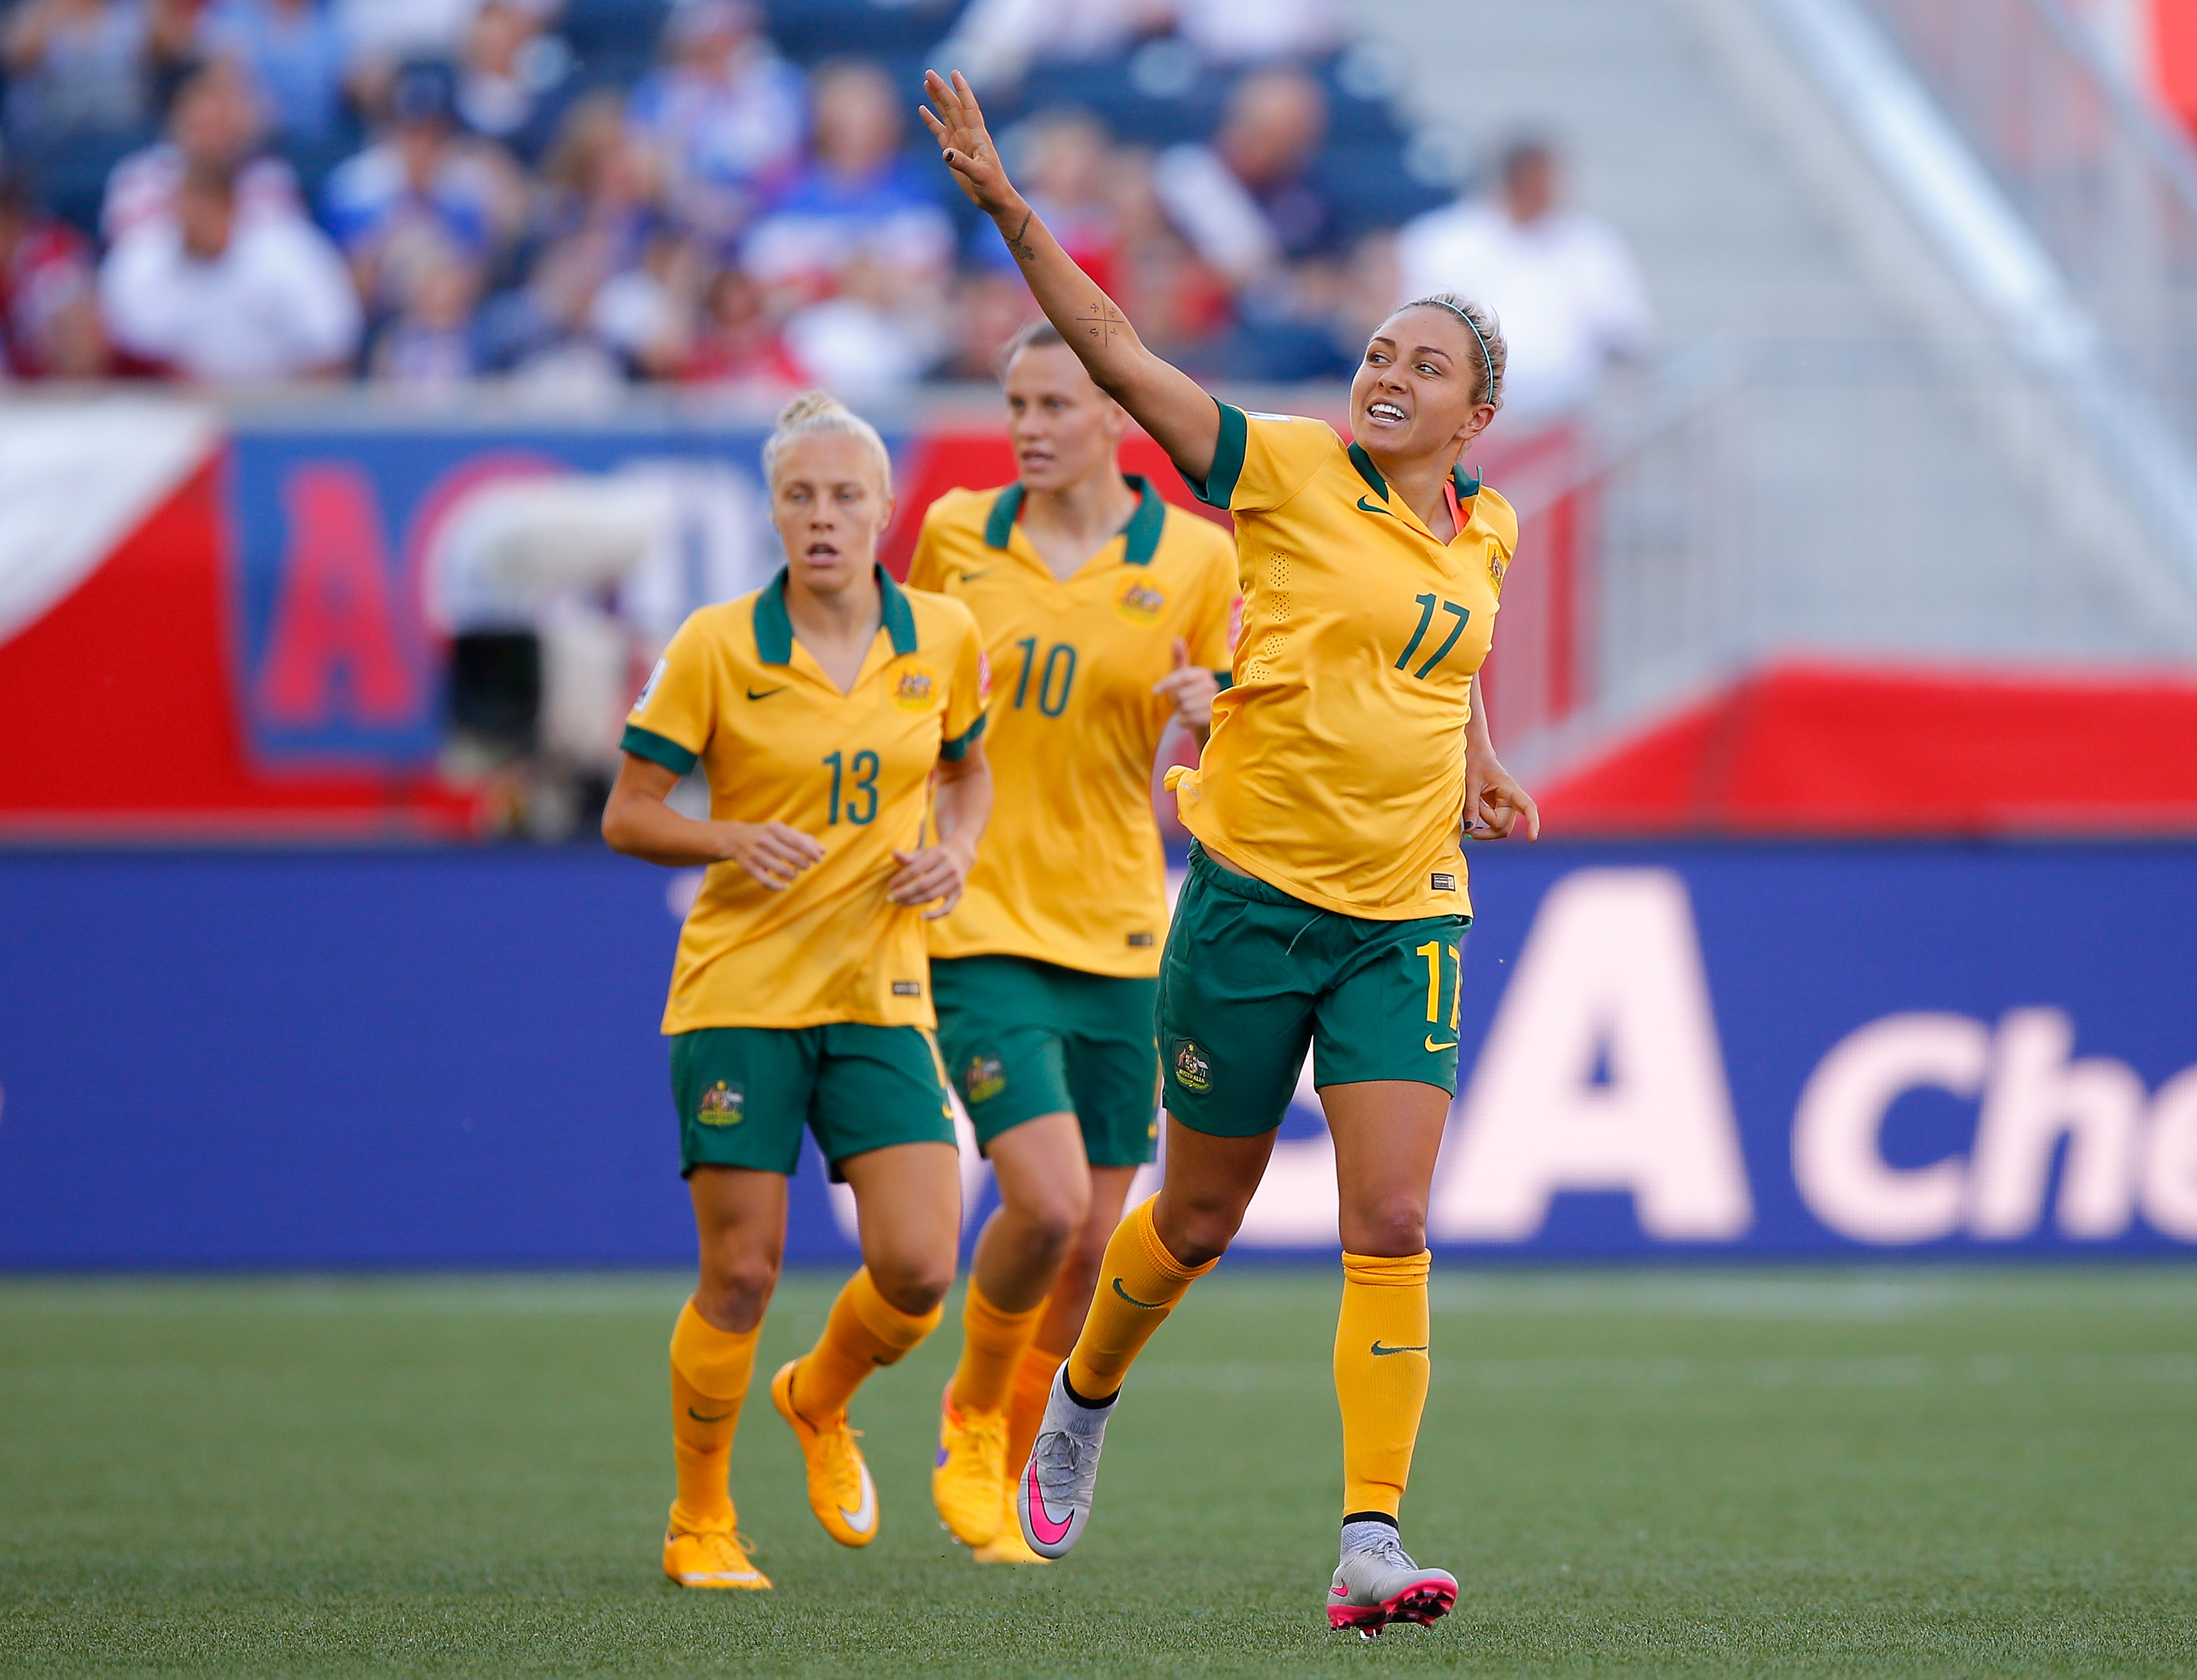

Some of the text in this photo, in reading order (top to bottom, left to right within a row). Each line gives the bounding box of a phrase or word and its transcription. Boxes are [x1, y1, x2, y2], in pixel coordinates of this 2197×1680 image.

[1090, 328, 1099, 337] S
[1394, 593, 1471, 680] 17
[1014, 637, 1076, 717] 10
[823, 750, 879, 825] 13
